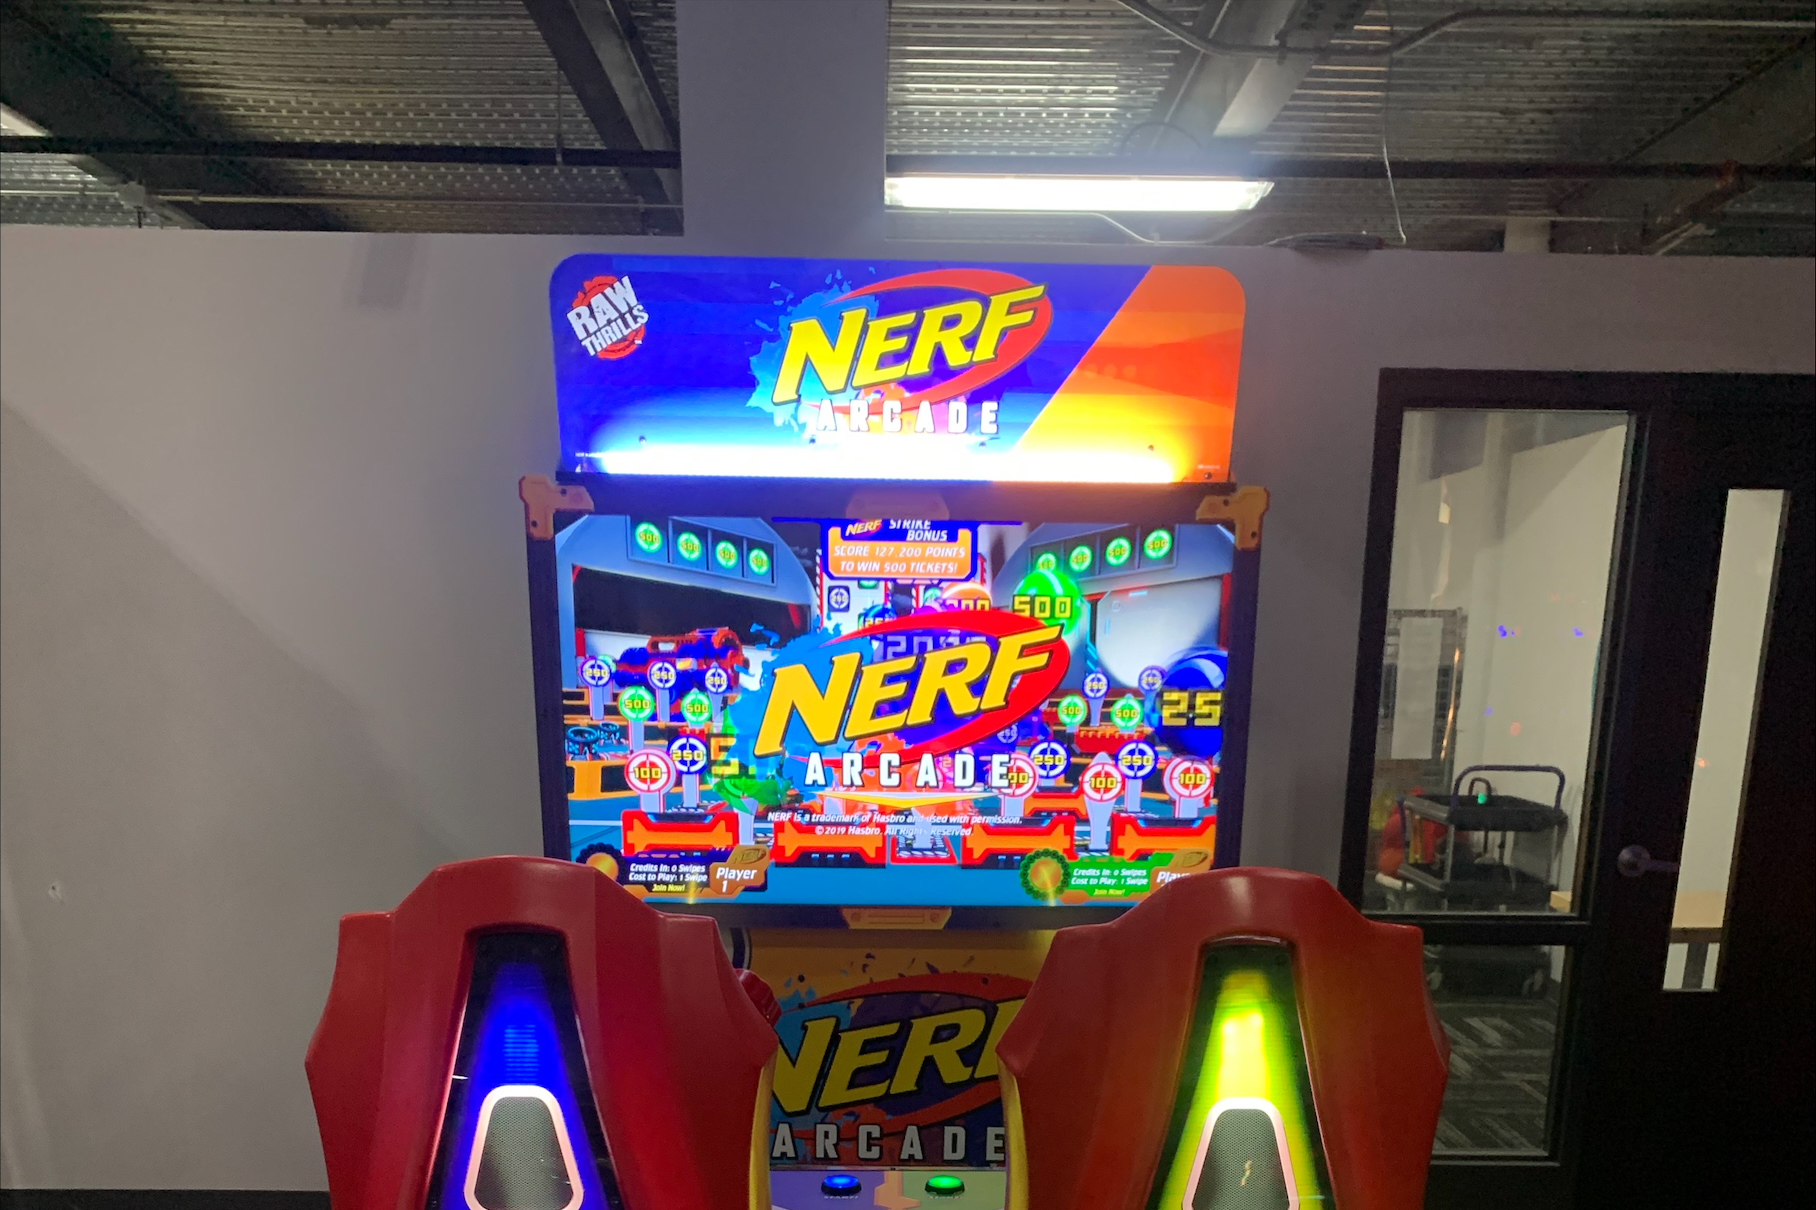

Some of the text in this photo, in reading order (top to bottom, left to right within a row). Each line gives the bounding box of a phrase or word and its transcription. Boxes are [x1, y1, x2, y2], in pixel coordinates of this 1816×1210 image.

[567, 275, 638, 341] RAW
[581, 304, 649, 357] THRILLS
[772, 283, 1048, 405] NERF
[816, 399, 999, 434] ARCADE
[906, 530, 948, 541] BONUS
[834, 546, 870, 557] SCORE
[925, 547, 966, 558] POINTS
[840, 561, 958, 574] TO WIN 500 TICKETS!
[1013, 595, 1073, 619] 500
[585, 669, 608, 679] 250
[754, 624, 1065, 758] NERF
[624, 699, 651, 709] 500
[686, 704, 709, 714] 500
[1061, 706, 1082, 716] 500
[1114, 708, 1138, 718] 500
[672, 749, 704, 762] 250
[1033, 754, 1065, 766] 250
[1121, 754, 1153, 767] 250
[633, 766, 662, 780] 100
[804, 752, 1011, 787] ARCADE
[1089, 777, 1117, 789] 100
[1179, 772, 1206, 785] 100
[767, 812, 791, 821] NERF
[811, 813, 859, 823] trademark
[873, 813, 905, 823] Hasbro
[949, 814, 969, 824] with
[630, 863, 657, 872] Credits
[678, 864, 706, 873] Swipes
[716, 867, 757, 881] Player
[1073, 868, 1100, 876] Credits
[629, 872, 646, 881] Cost
[647, 873, 656, 881] to
[1071, 877, 1088, 885] Cost
[721, 880, 728, 893] 1
[772, 1123, 1005, 1161] ARCADE
